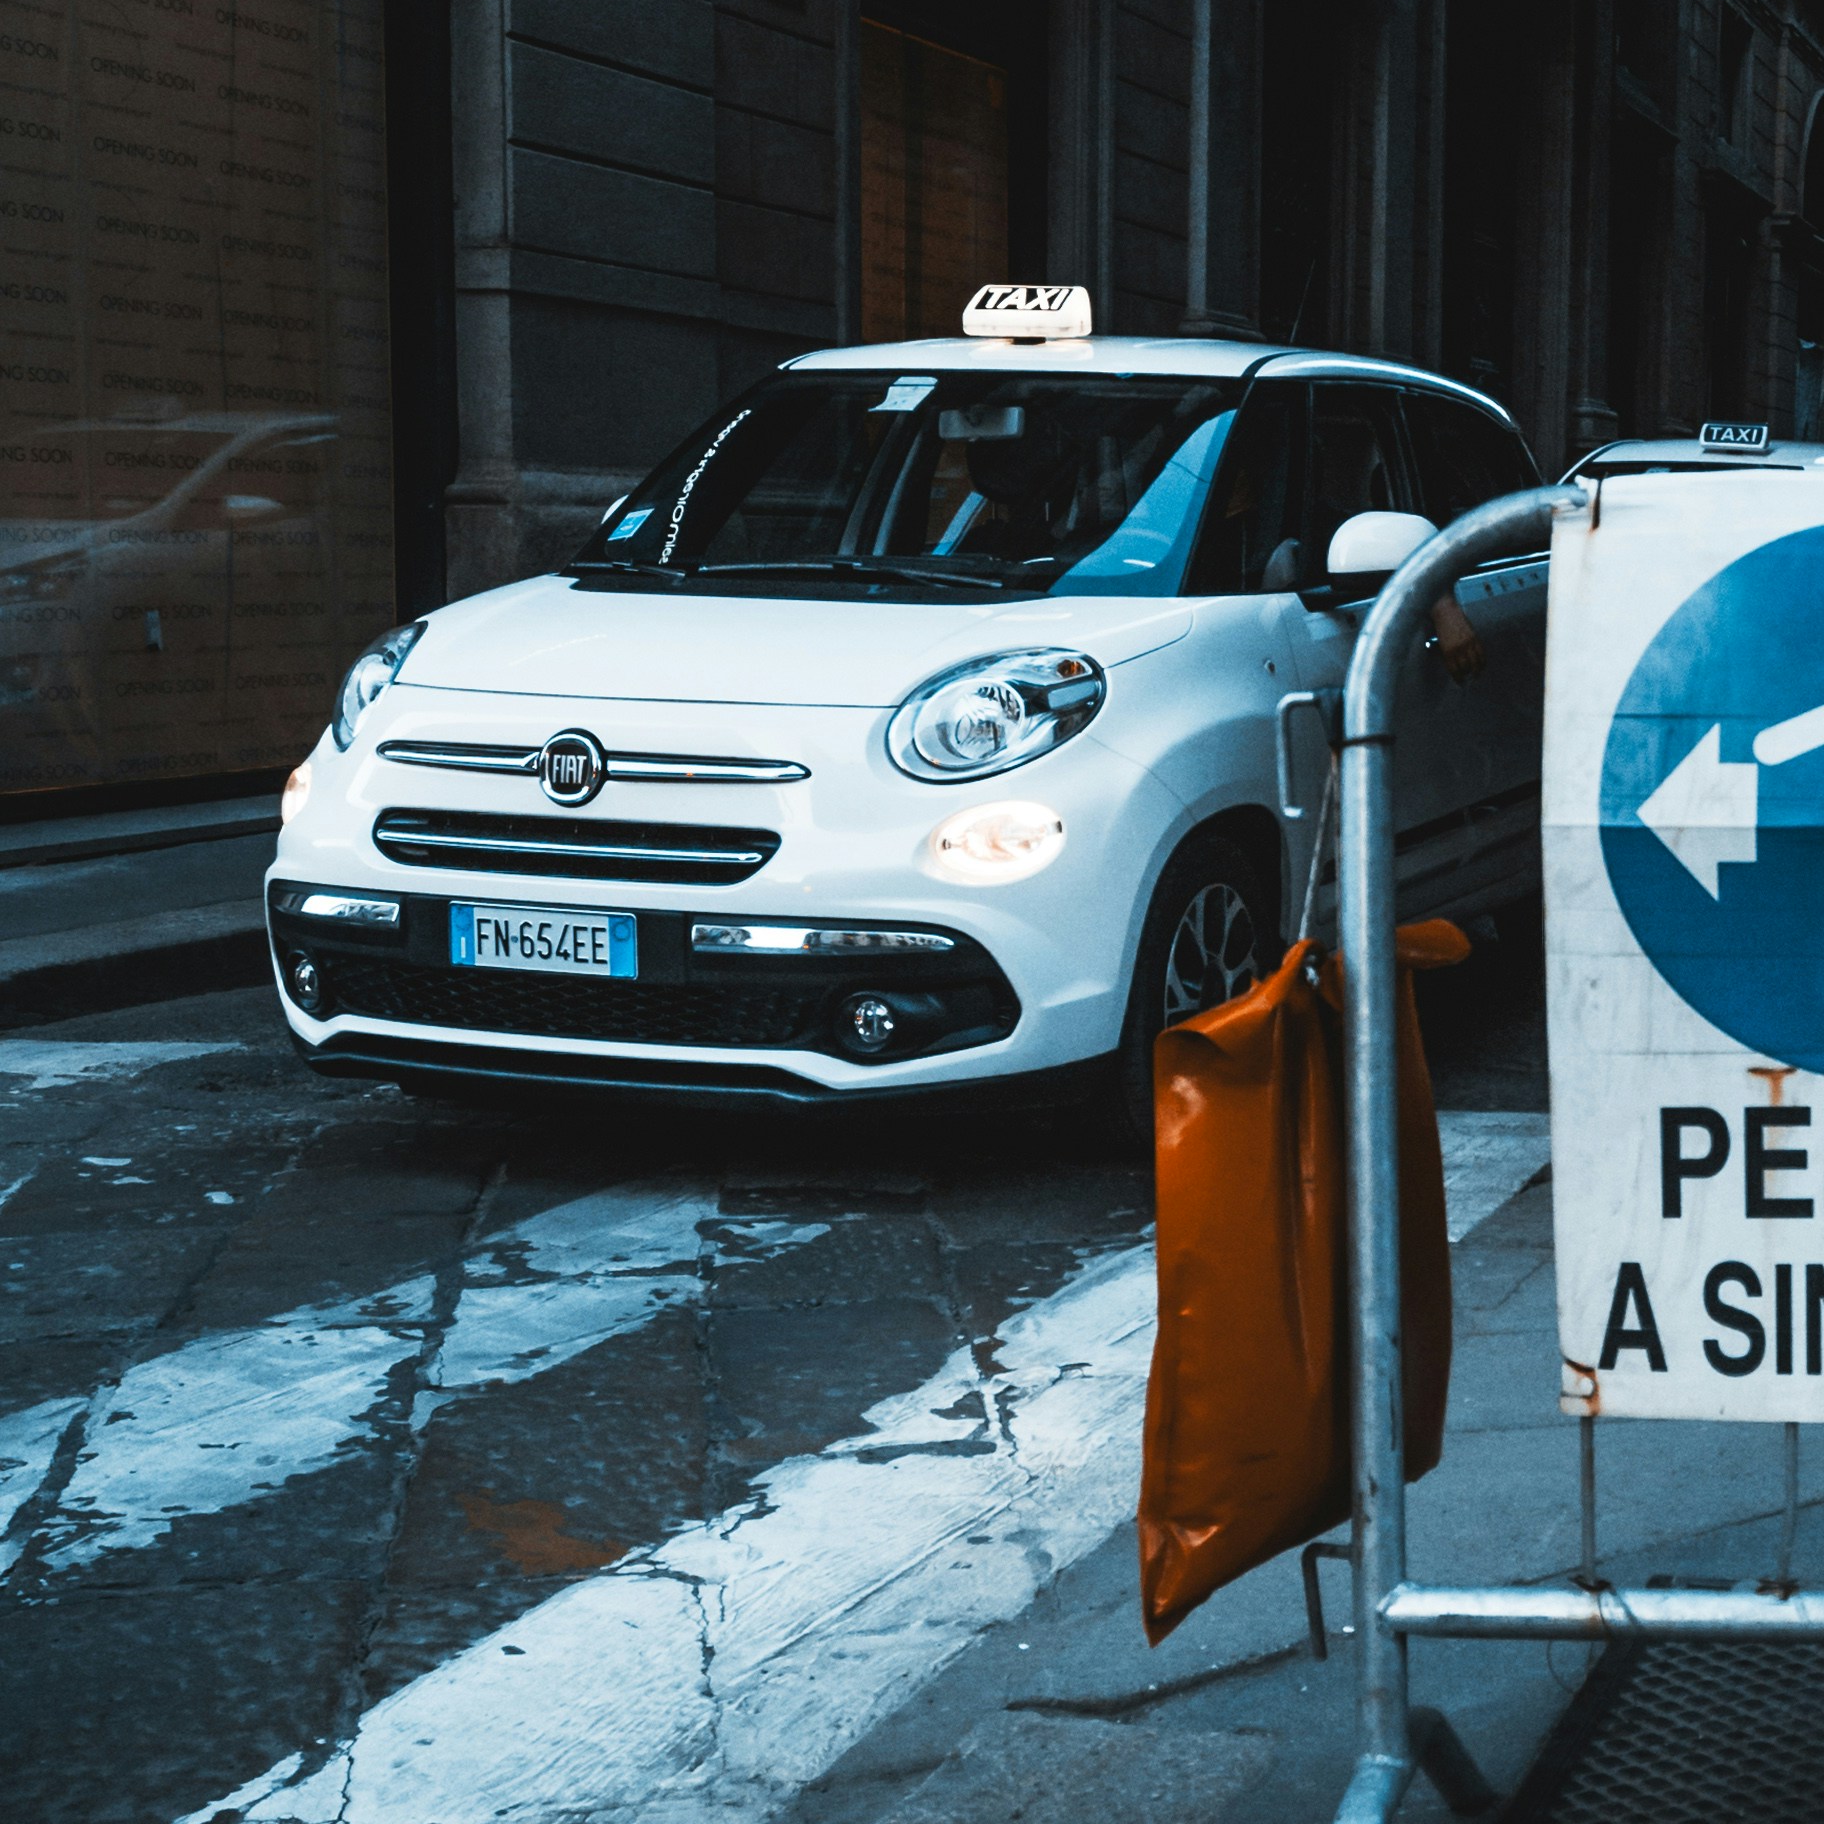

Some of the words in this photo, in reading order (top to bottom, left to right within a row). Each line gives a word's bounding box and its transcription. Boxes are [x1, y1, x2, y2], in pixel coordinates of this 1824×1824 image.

[985, 287, 1070, 310] TAXI
[1710, 426, 1760, 443] TAXI
[552, 754, 588, 785] FIAT
[1598, 1260, 1669, 1373] A
